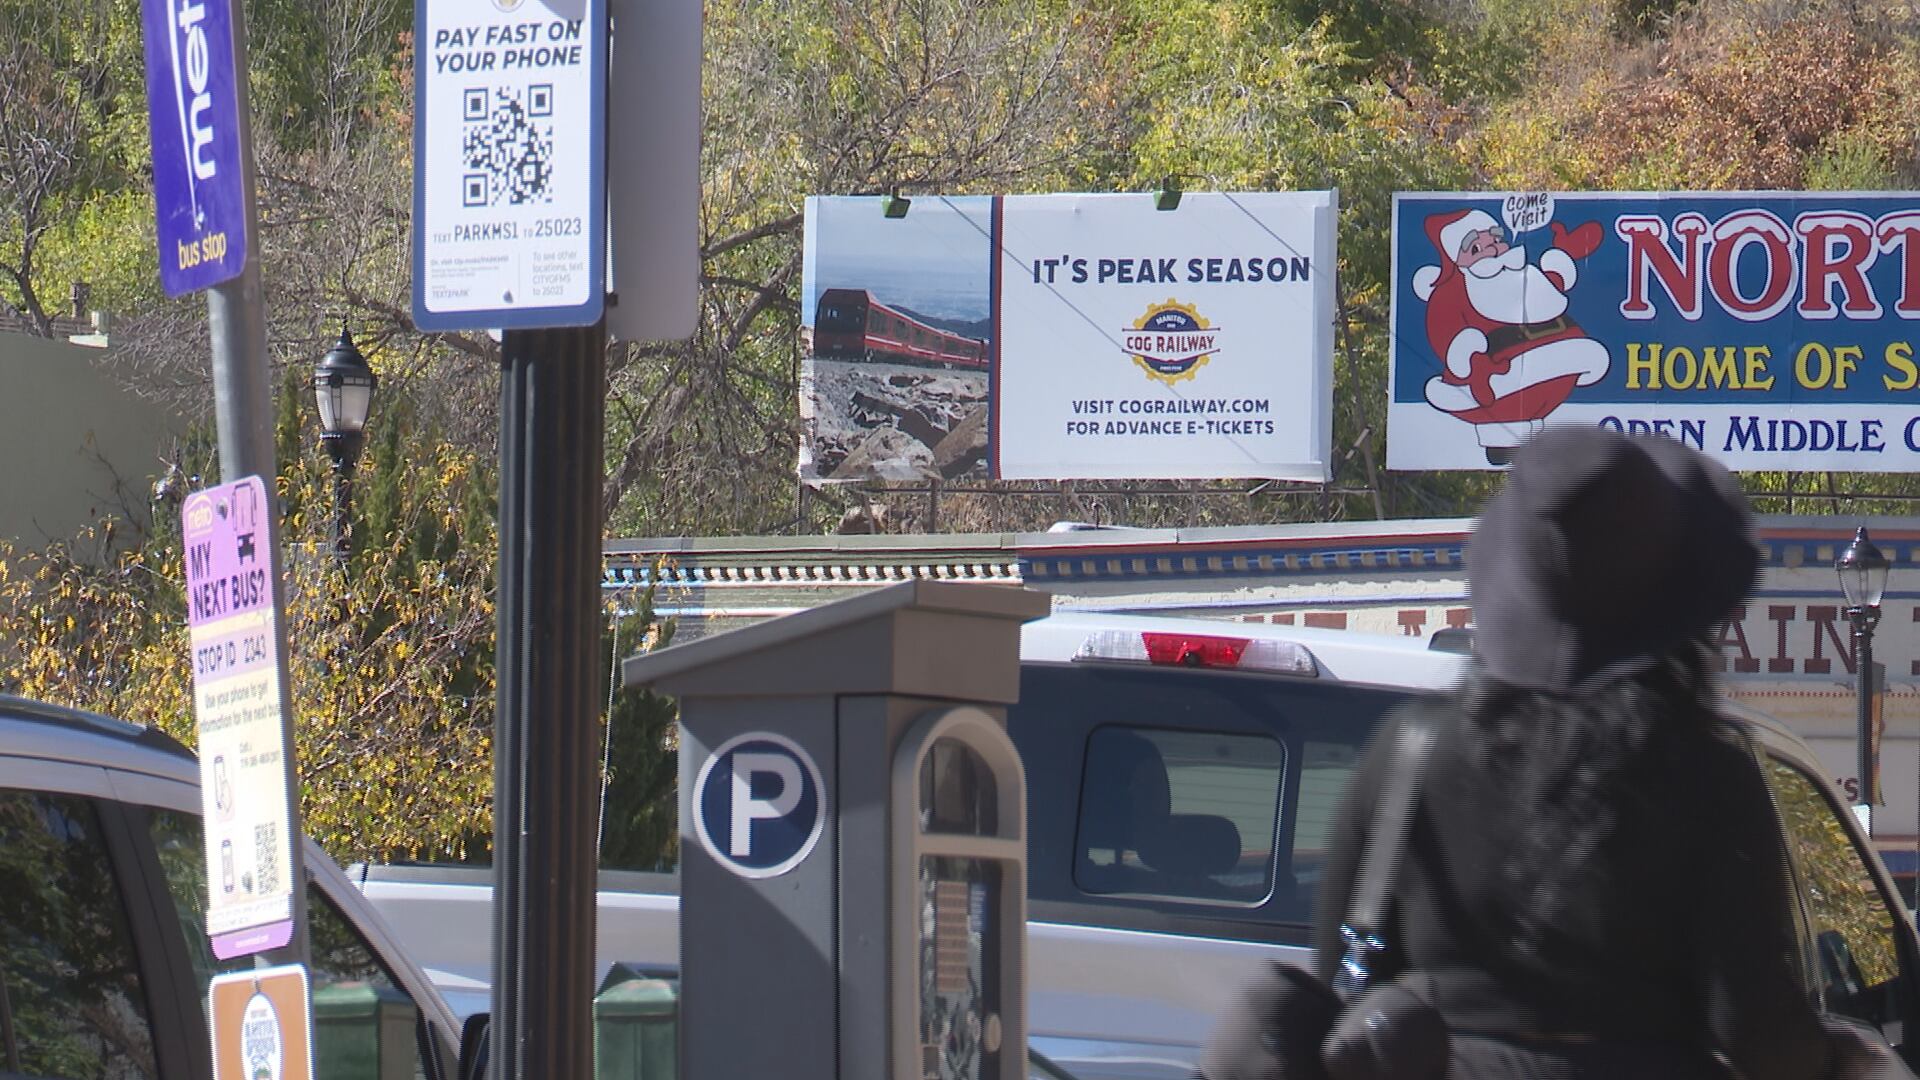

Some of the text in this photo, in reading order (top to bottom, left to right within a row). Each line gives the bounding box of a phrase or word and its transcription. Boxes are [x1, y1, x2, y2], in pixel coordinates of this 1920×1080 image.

[434, 19, 583, 49] PAY FAST ON
[435, 45, 583, 74] YOUR PHONE
[433, 233, 452, 243] TEXT
[454, 222, 519, 242] PARKMS1
[535, 217, 582, 237] 25023
[177, 231, 227, 270] bus stop
[1033, 254, 1310, 284] IT'S PEAK SEASON
[1127, 335, 1215, 353] COG RAILWAY
[1625, 343, 1776, 391] HOME
[1795, 342, 1864, 390] OF
[1072, 399, 1269, 414] VISIT COGRAILWAY.COM
[1067, 420, 1274, 435] FOR ADVANCE E-TICKETS
[1723, 416, 1886, 453] MIDDLE
[190, 541, 212, 580] MY
[193, 568, 265, 621] NEXT BUS?
[197, 644, 222, 674] STOP
[225, 640, 236, 667] ID
[730, 753, 804, 857] P
